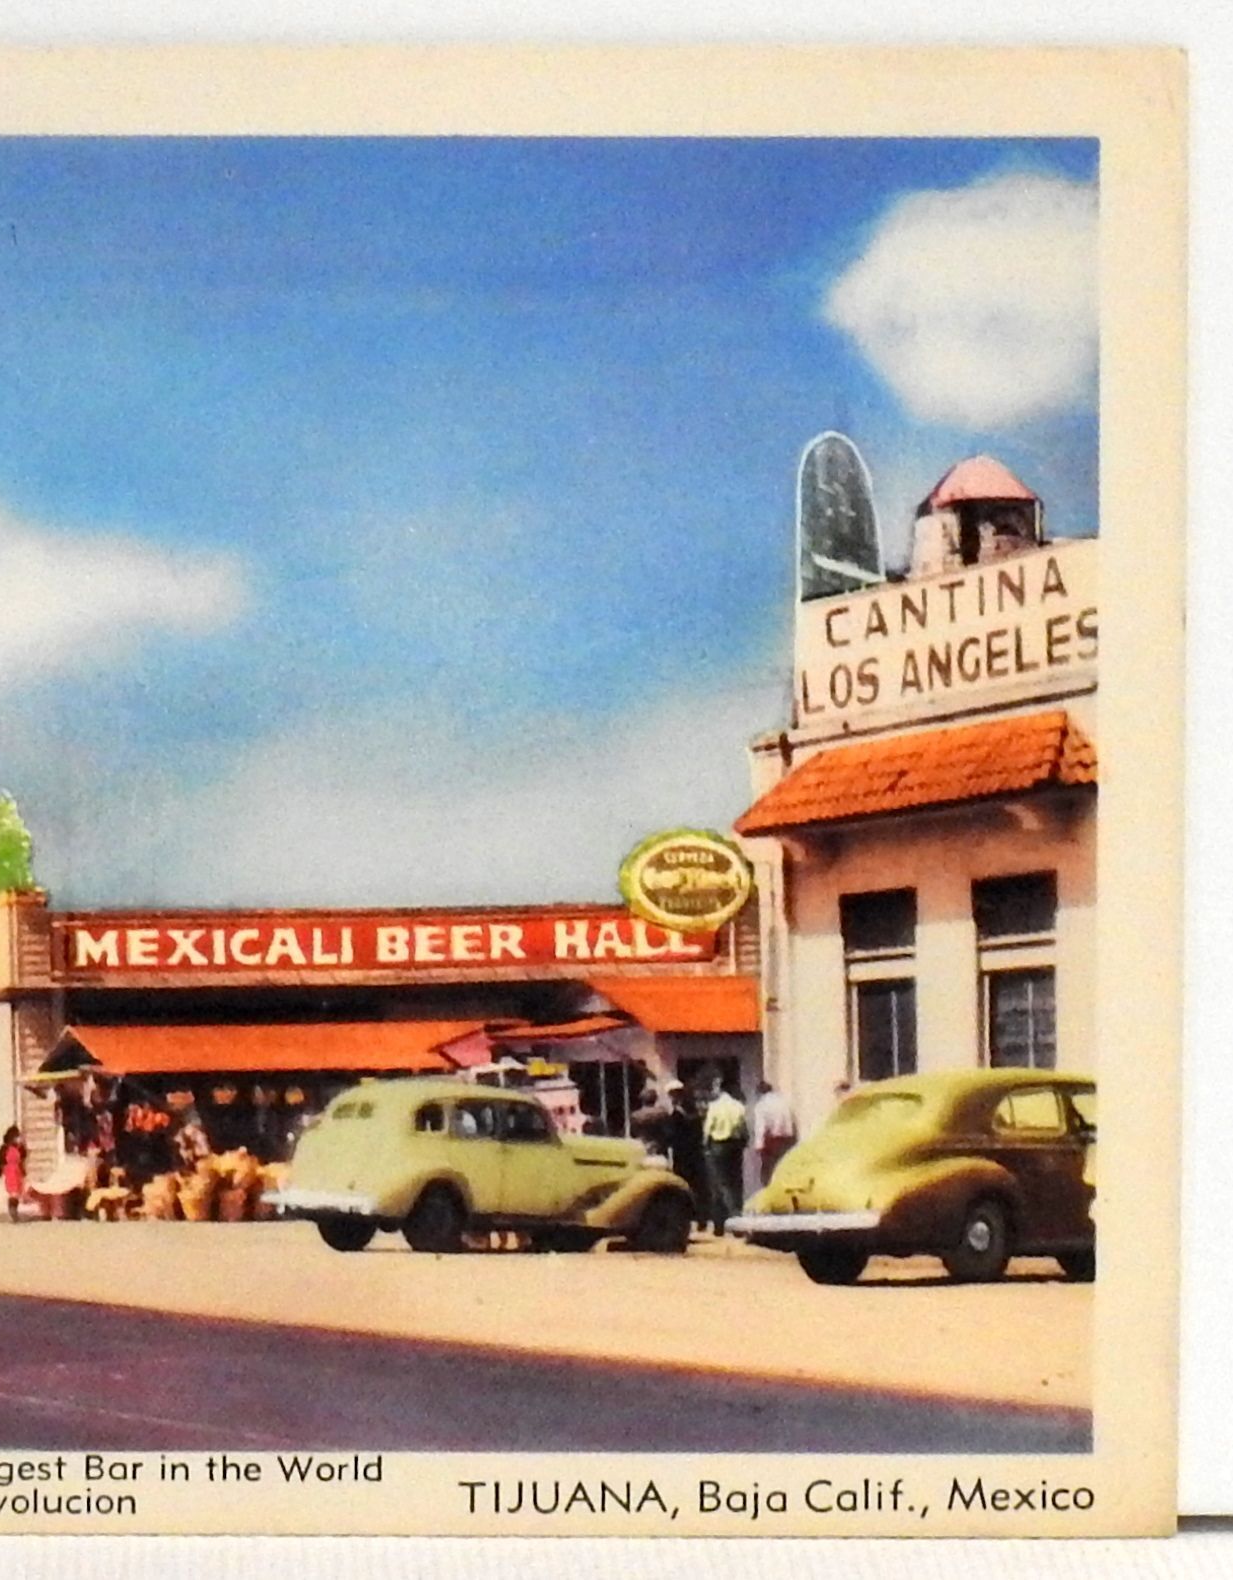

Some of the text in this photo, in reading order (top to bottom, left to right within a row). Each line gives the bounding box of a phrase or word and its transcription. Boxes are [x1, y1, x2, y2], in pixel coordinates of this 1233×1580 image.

[824, 556, 1068, 649] CANTINA
[801, 607, 1099, 715] LOS ANGELES
[75, 919, 703, 967] MEXICALI BEER HALL
[85, 1455, 144, 1481] Bar
[160, 1455, 190, 1481] in
[206, 1455, 262, 1481] the
[278, 1455, 382, 1481] World
[458, 1477, 1095, 1519] TIJUANA, Baja Calif., Mexico
